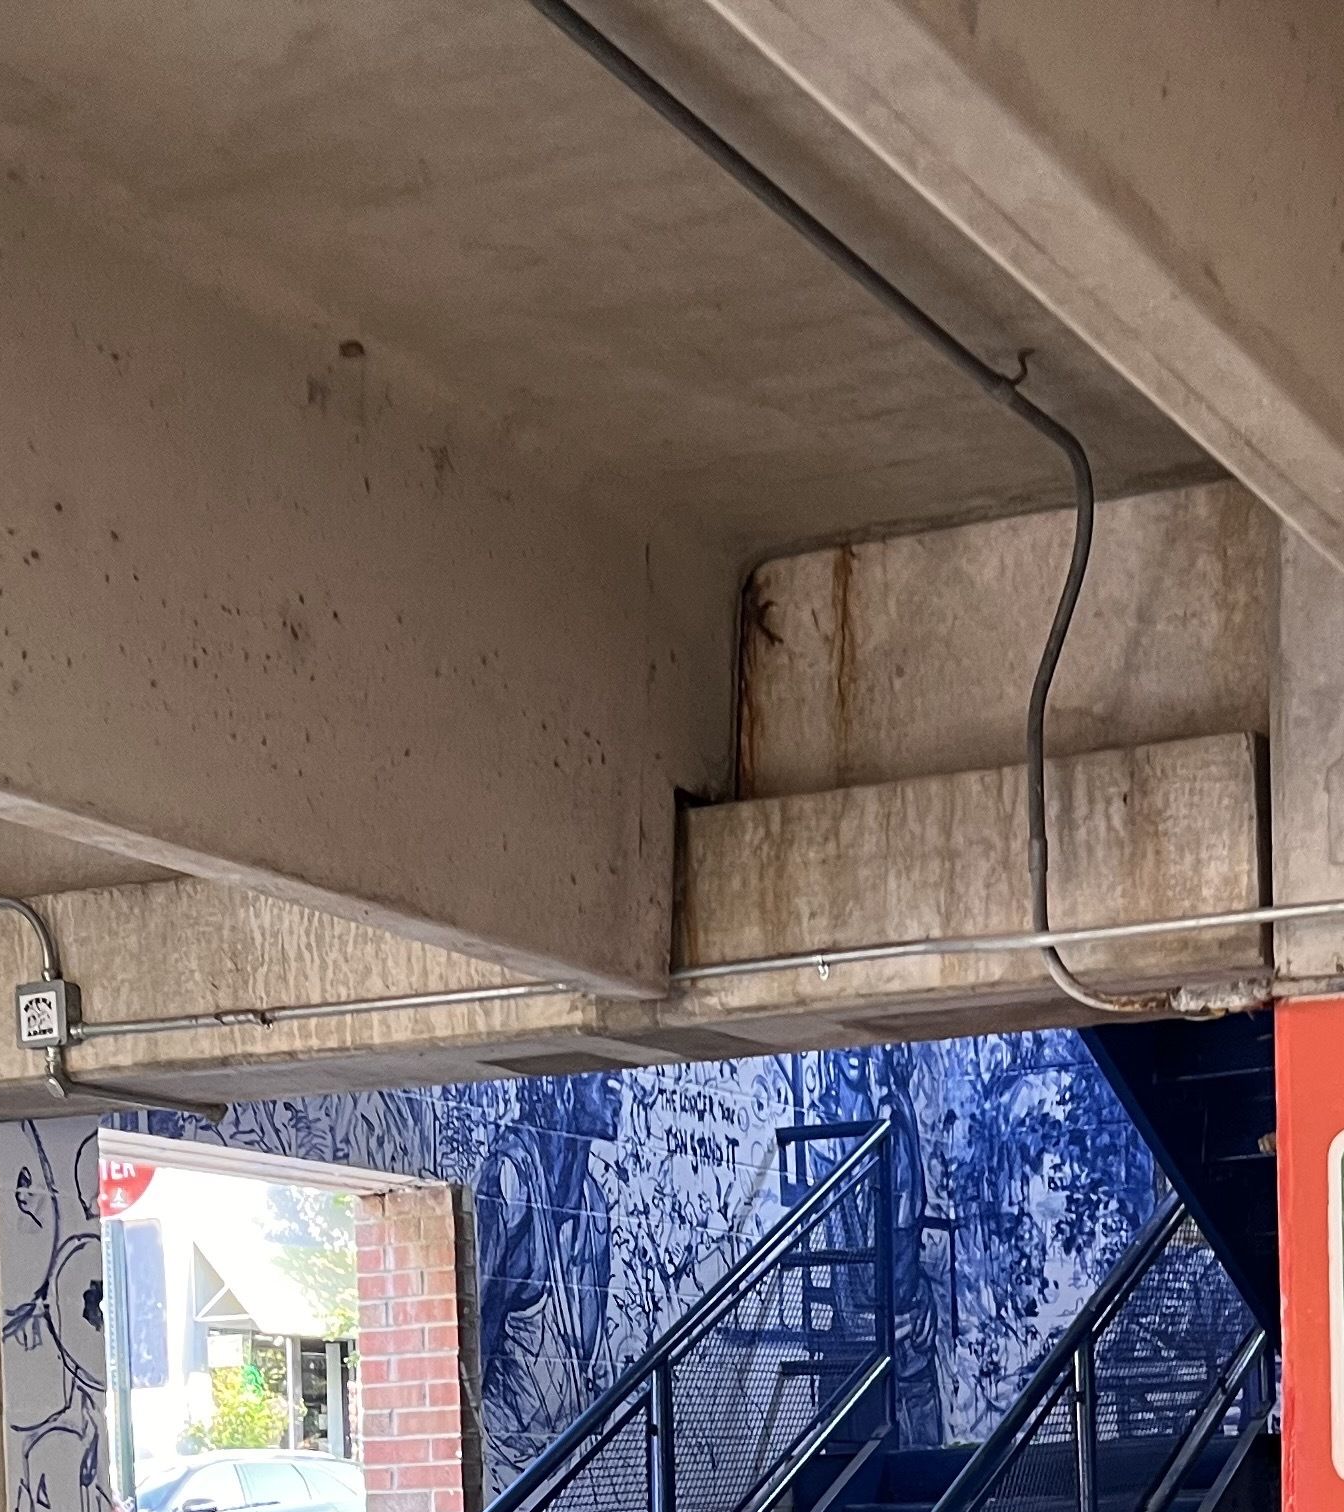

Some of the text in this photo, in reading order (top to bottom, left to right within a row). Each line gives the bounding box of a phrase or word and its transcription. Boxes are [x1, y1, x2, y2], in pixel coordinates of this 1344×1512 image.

[658, 1087, 677, 1113] THE
[664, 1124, 739, 1178] CAN STAND IT
